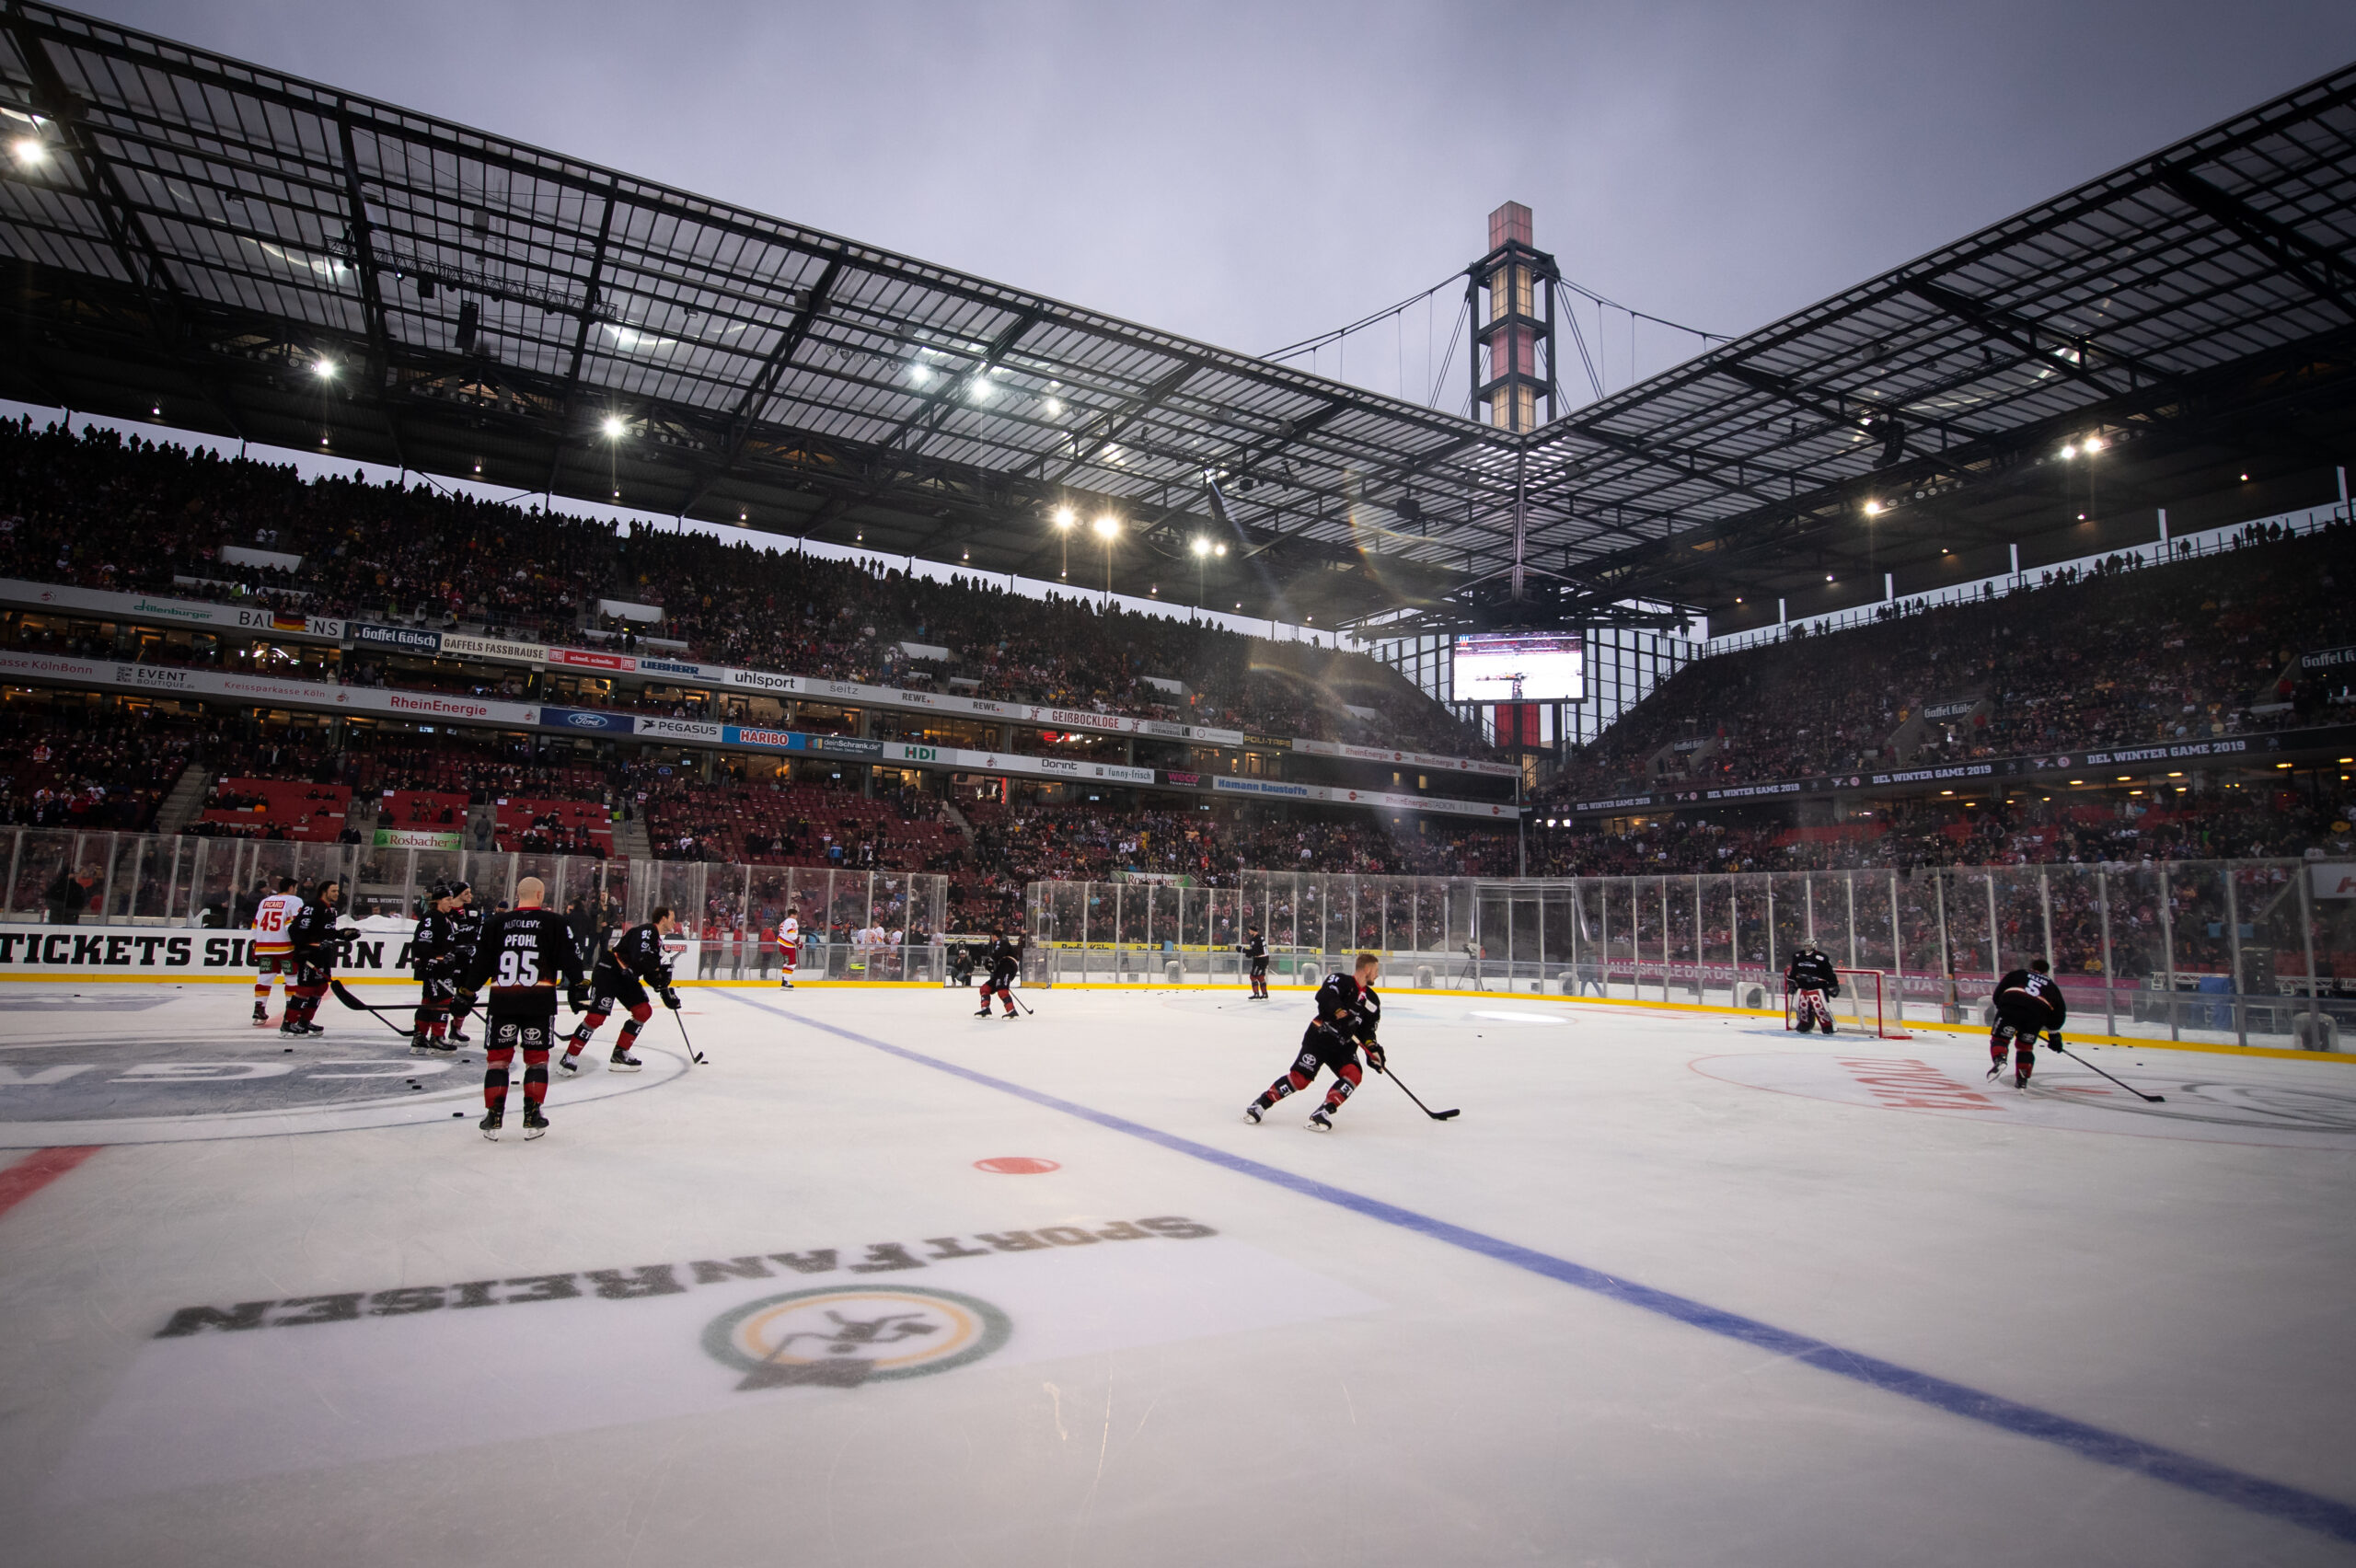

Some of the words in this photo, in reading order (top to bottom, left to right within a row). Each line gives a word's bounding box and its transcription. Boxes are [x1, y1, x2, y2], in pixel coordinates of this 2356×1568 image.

[363, 627, 397, 642] Gaffel
[398, 631, 436, 648] Kölsch
[444, 638, 483, 651] GAFFELS
[485, 643, 544, 659] FASSBRAUSE
[31, 659, 93, 674] KölnBonn
[2302, 651, 2343, 668] Gaffel
[138, 668, 187, 681] EVENT
[641, 661, 699, 674] LIEBHERR
[735, 672, 795, 688] uhlsport
[225, 681, 300, 696] Kreissparkasse
[304, 688, 325, 698] Köln
[829, 683, 859, 695] seitz
[902, 693, 927, 703] REWE
[390, 696, 487, 716] RheinEnergie
[973, 701, 997, 711] REWE
[575, 714, 599, 726] Ford
[658, 721, 718, 735] PEGASUS
[739, 729, 789, 746] HARIBO
[905, 746, 936, 761] HDI
[1345, 747, 1389, 761] RheinEnergie
[2087, 753, 2111, 765] DEL
[2113, 748, 2167, 763] WINTER
[2170, 744, 2210, 757] GAME
[2213, 741, 2246, 754] 2019
[1042, 758, 1078, 770] Dorint
[1415, 755, 1455, 768] RheinEnergie
[1108, 769, 1151, 780] funny-frisch
[1478, 763, 1518, 775] RheinEnergie
[1873, 775, 1891, 784] DEL
[1892, 769, 1934, 781] WINTER
[1935, 767, 1965, 778] GAME
[1967, 765, 1992, 776] 2019
[1167, 772, 1199, 783] weco
[1218, 778, 1259, 790] Hamann
[1261, 783, 1308, 796] Baustoffe
[1723, 787, 1755, 797] WINTER
[1756, 785, 1779, 794] GAME
[1781, 783, 1800, 792] 2019
[389, 834, 449, 847] Rosbacher
[260, 911, 283, 932] 45
[424, 917, 432, 928] 3
[503, 934, 538, 948] PFOHL
[0, 933, 191, 966] TICKETS
[497, 950, 539, 987] 95
[2025, 979, 2042, 997] 5
